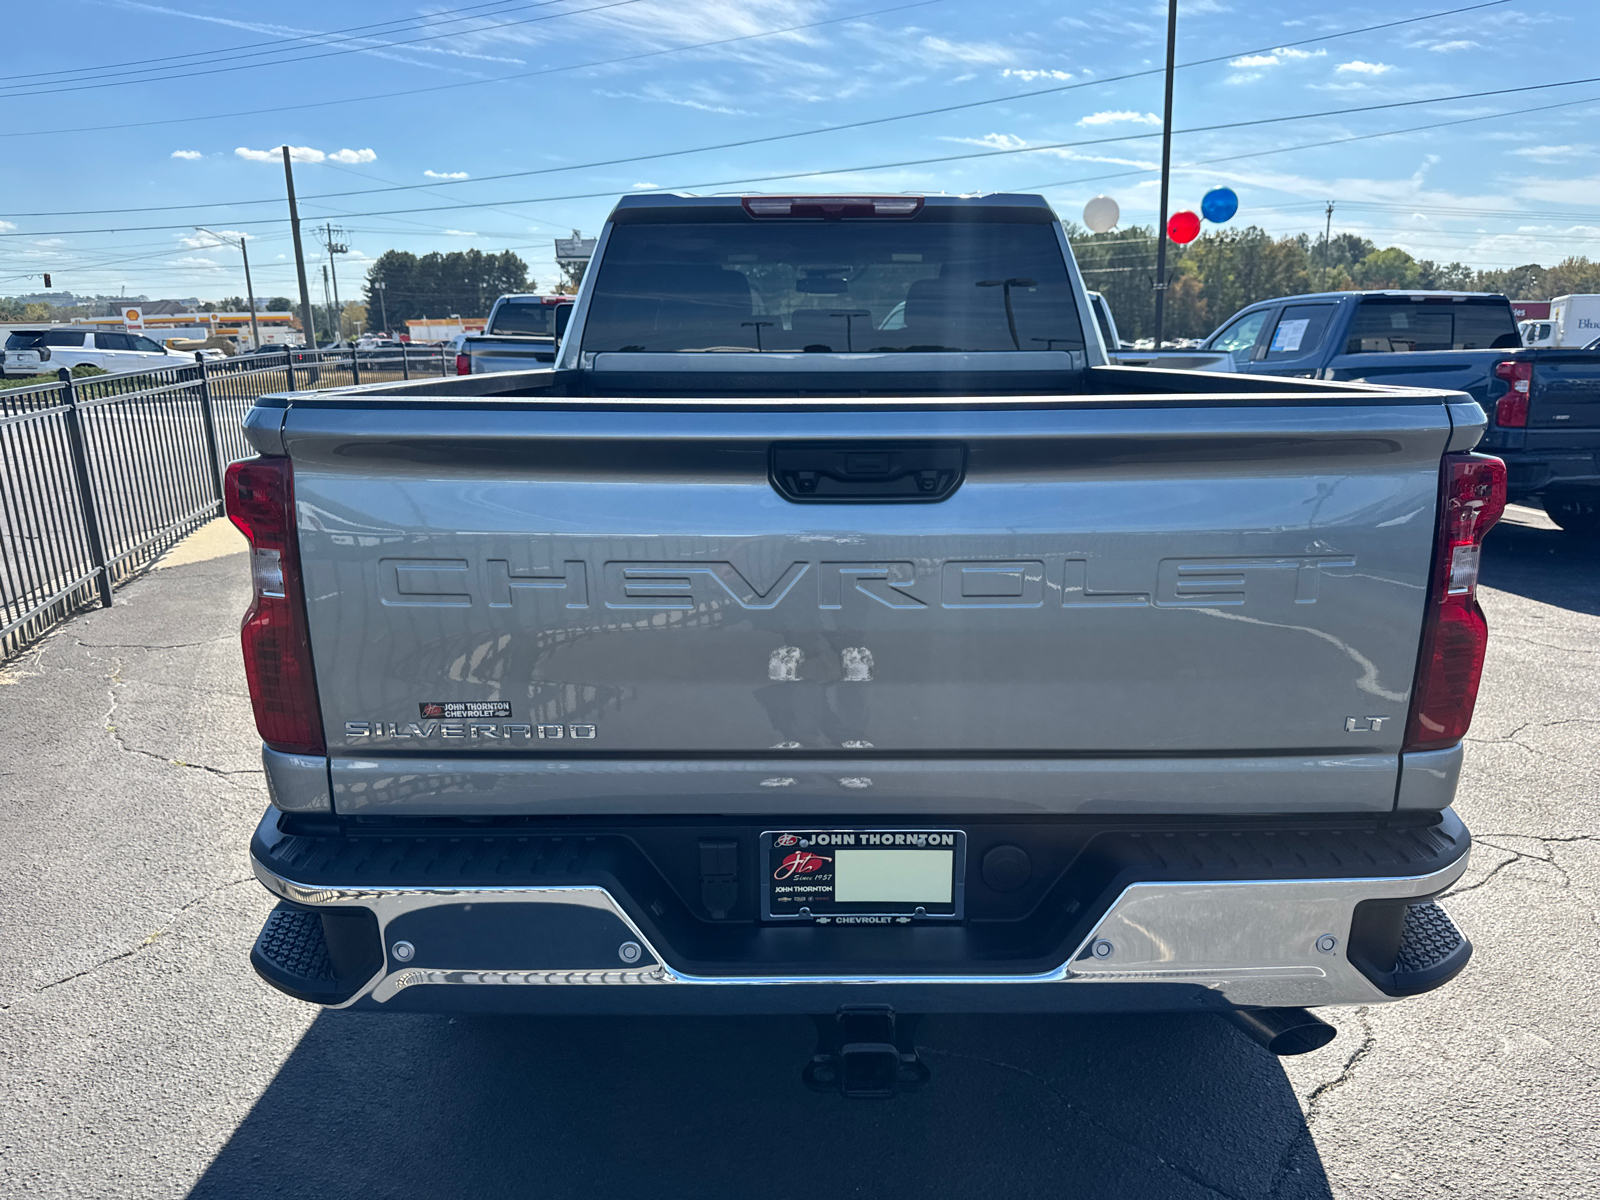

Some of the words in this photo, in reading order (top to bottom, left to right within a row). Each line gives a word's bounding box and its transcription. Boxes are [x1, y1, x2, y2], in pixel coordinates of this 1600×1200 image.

[377, 554, 1357, 611] CHEVROLET
[444, 703, 465, 711] JOHN
[465, 702, 510, 711] THORNTON
[444, 710, 494, 718] CHEVROLET
[1344, 714, 1391, 732] LT
[344, 721, 598, 740] SILVERADO
[808, 833, 856, 846] JOHN
[859, 833, 954, 846] THORNTON
[814, 873, 833, 881] 1957
[775, 885, 794, 893] JOHN
[794, 885, 833, 893] THORNTON
[835, 916, 892, 924] CHEVROLET
